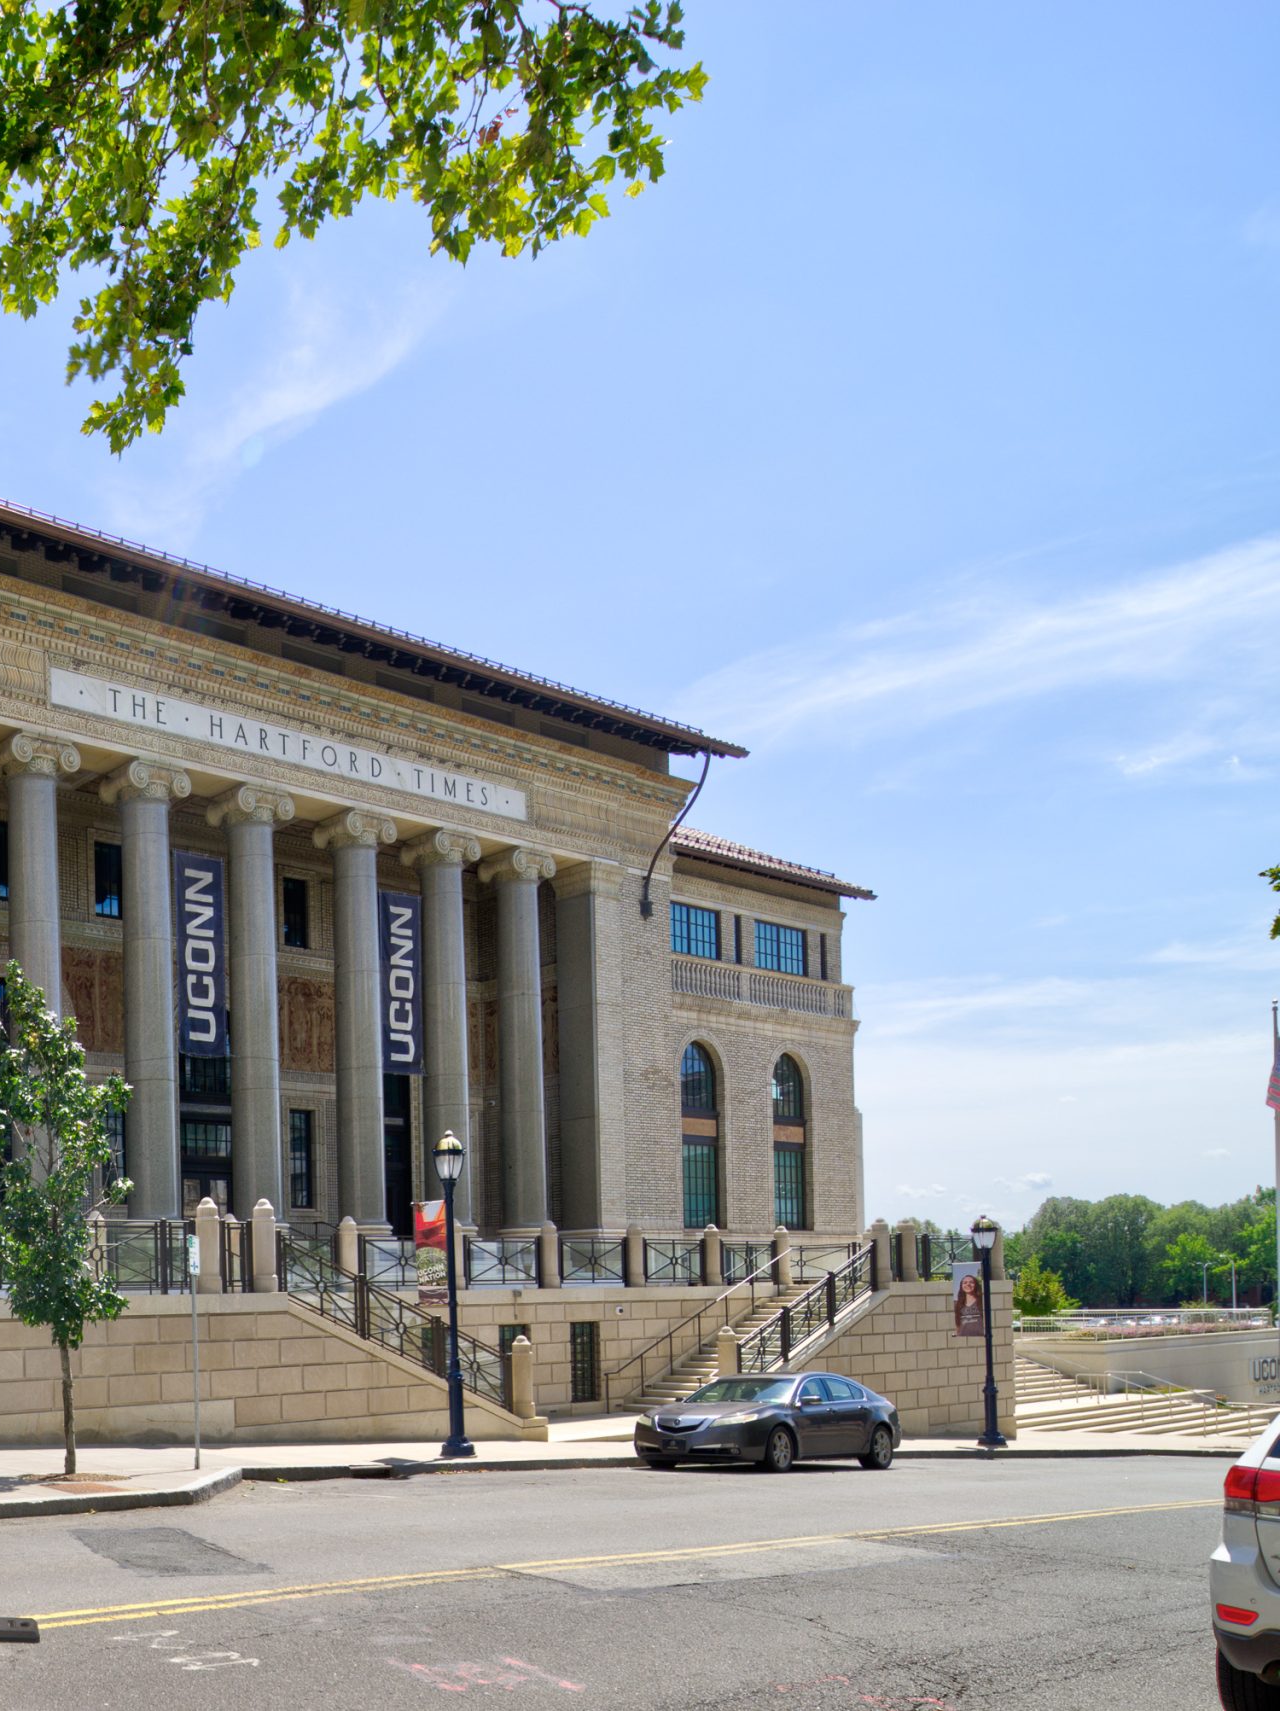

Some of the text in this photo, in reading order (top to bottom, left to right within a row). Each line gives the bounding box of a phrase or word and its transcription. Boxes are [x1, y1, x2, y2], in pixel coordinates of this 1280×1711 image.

[108, 688, 488, 806] THE HARTFORD TIMES
[184, 867, 217, 1043] UCONN
[389, 904, 416, 1063] UCONN
[417, 1263, 445, 1277] UCONN
[418, 1271, 447, 1284] NATION
[1253, 1358, 1279, 1382] UCO
